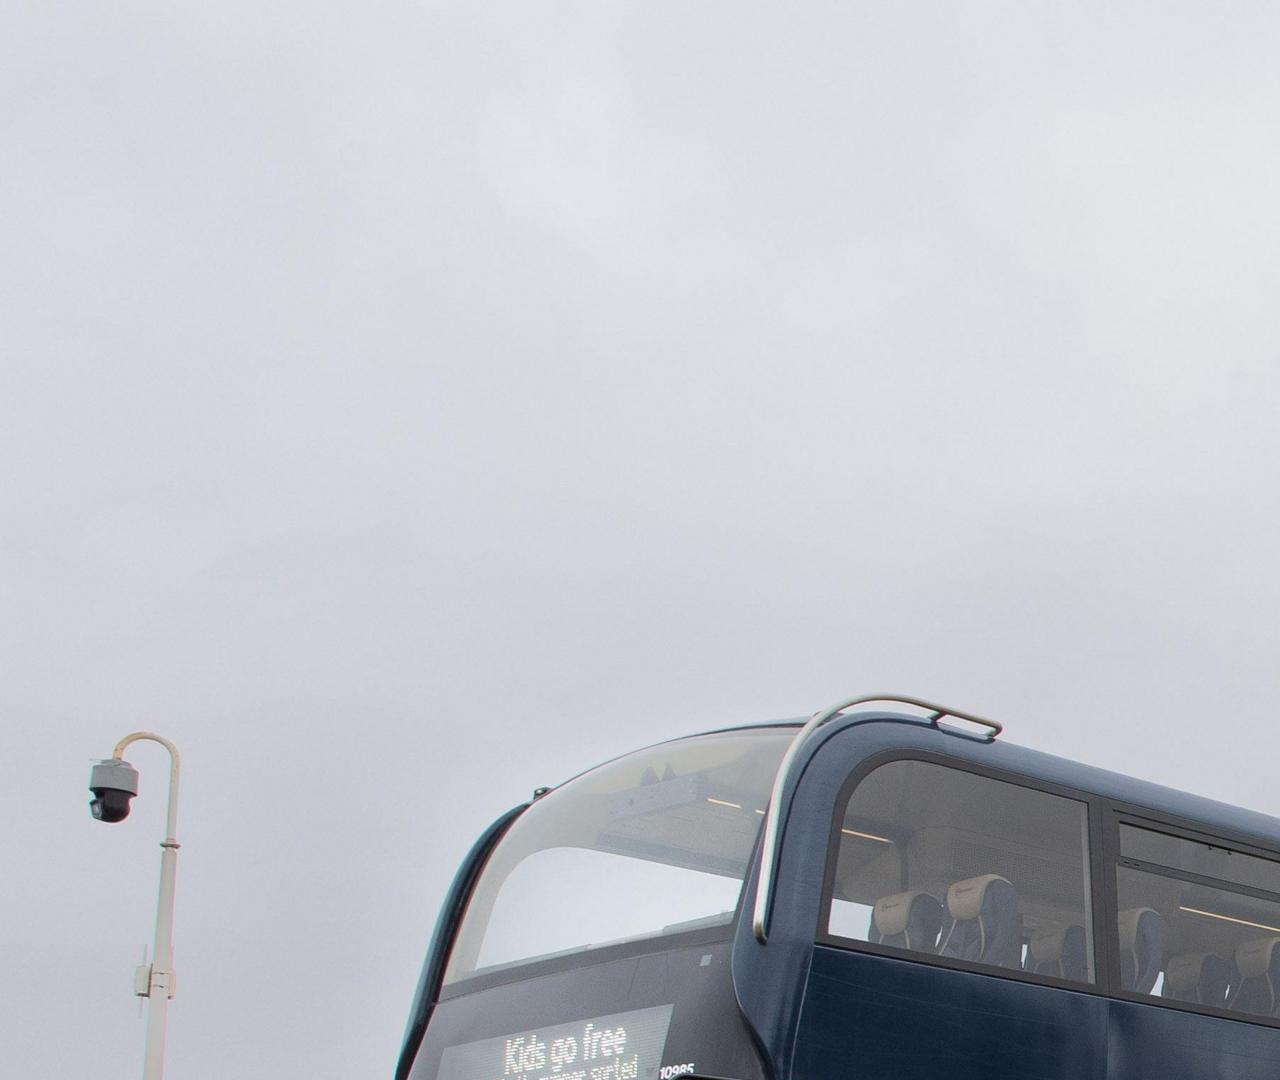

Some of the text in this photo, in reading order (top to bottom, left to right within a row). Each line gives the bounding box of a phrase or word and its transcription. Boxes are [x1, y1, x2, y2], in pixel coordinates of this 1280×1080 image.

[504, 1023, 627, 1075] Kids go free
[660, 1063, 695, 1079] 10985
